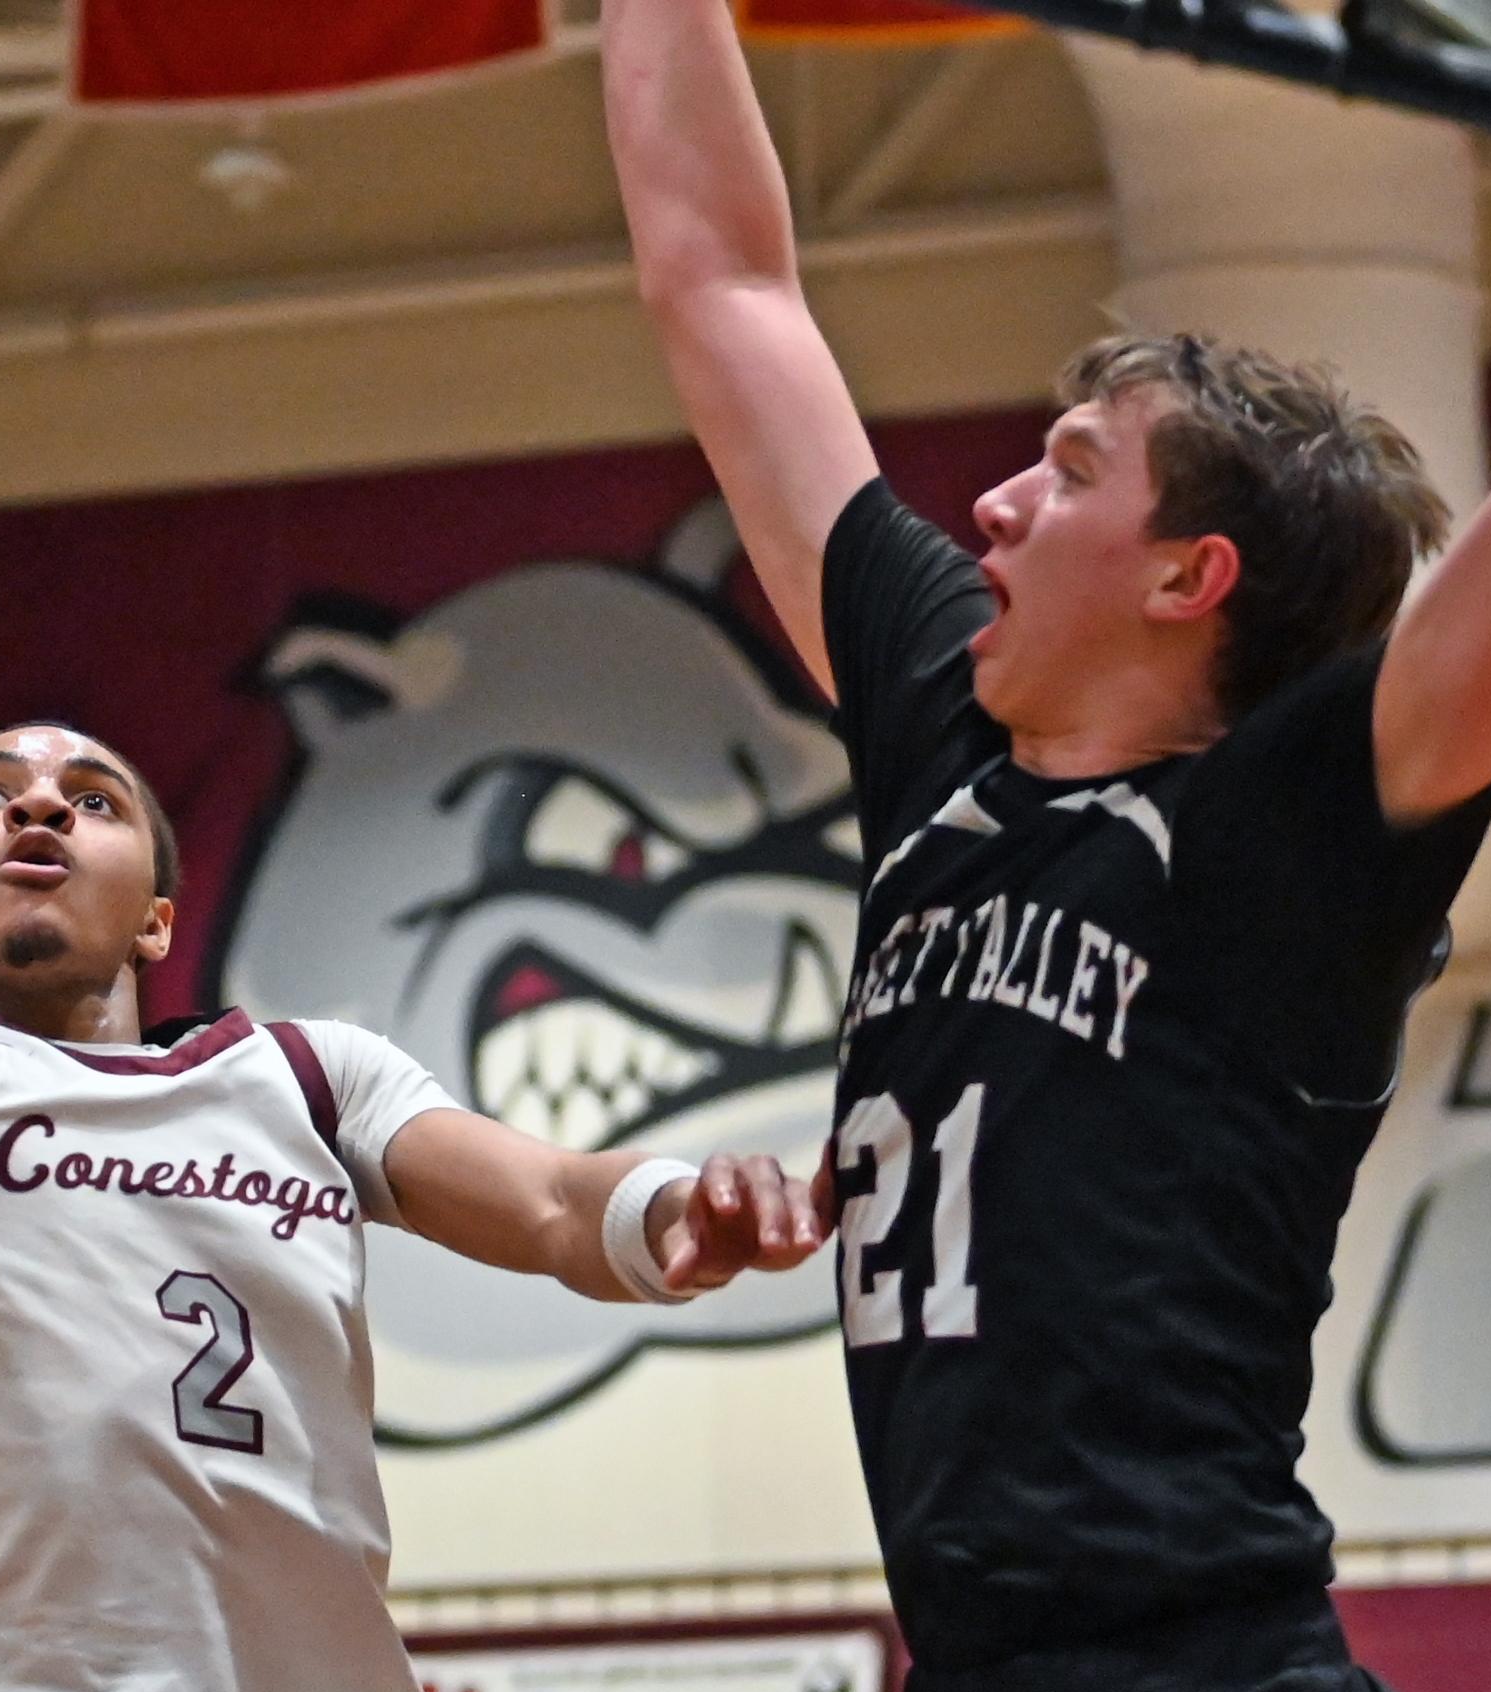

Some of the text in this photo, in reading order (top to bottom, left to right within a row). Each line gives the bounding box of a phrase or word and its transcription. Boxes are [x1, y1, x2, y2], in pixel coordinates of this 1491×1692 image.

[941, 893, 1151, 1060] VALLEY
[834, 1082, 987, 1349] 21
[154, 1269, 265, 1455] 2
